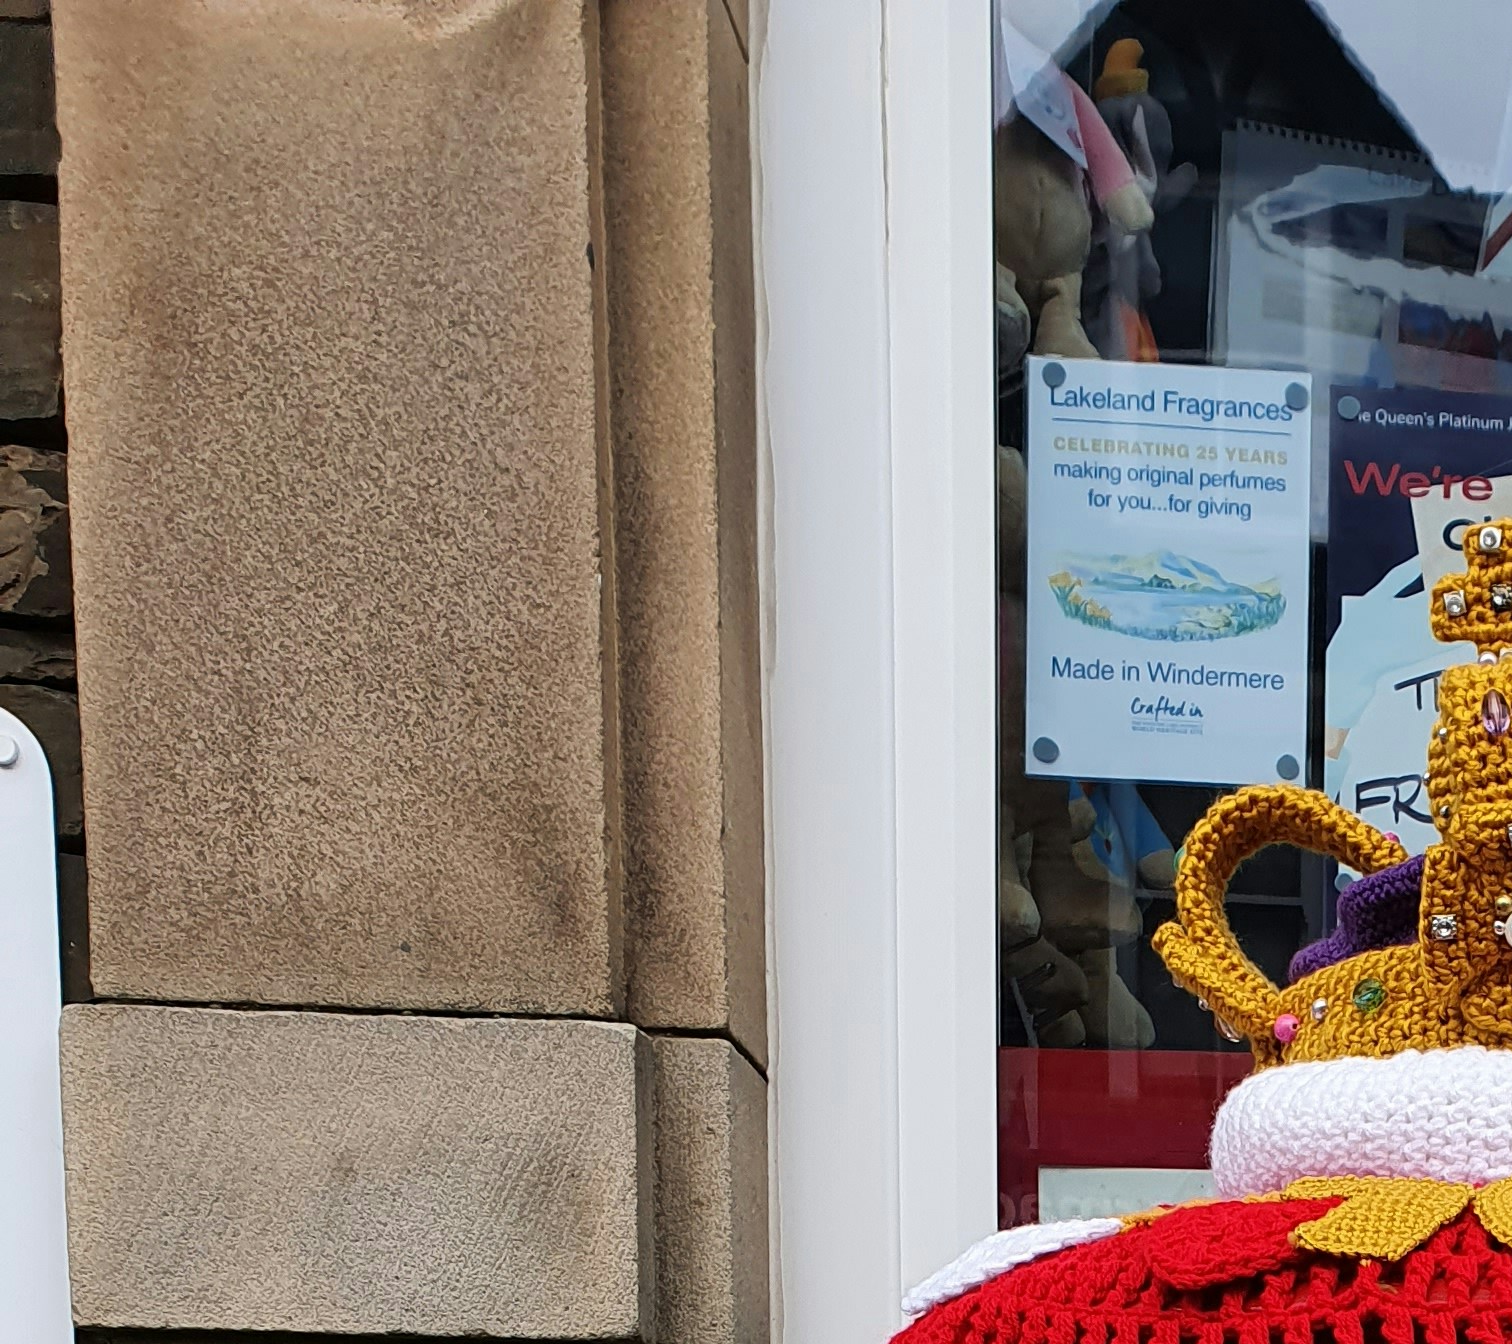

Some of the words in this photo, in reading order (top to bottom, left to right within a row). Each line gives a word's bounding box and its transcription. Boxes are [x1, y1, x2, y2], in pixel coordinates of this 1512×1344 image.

[1050, 386, 1155, 411] Lakeland
[1163, 390, 1293, 422] Fragrances
[1375, 408, 1435, 428] Queen's
[1439, 412, 1503, 430] Platinum
[1053, 436, 1189, 458] CELEBRATING
[1196, 446, 1218, 460] 25
[1225, 447, 1288, 465] YEARS
[1054, 462, 1121, 487] making
[1127, 466, 1194, 487] original
[1200, 471, 1286, 492] perfumes
[1344, 459, 1493, 501] We're
[1088, 491, 1111, 506] for
[1197, 494, 1251, 521] giving
[1052, 656, 1115, 680] Made
[1121, 660, 1140, 681] in
[1148, 661, 1285, 690] Windermere
[1131, 696, 1186, 721] Crafted
[1189, 702, 1203, 717] in
